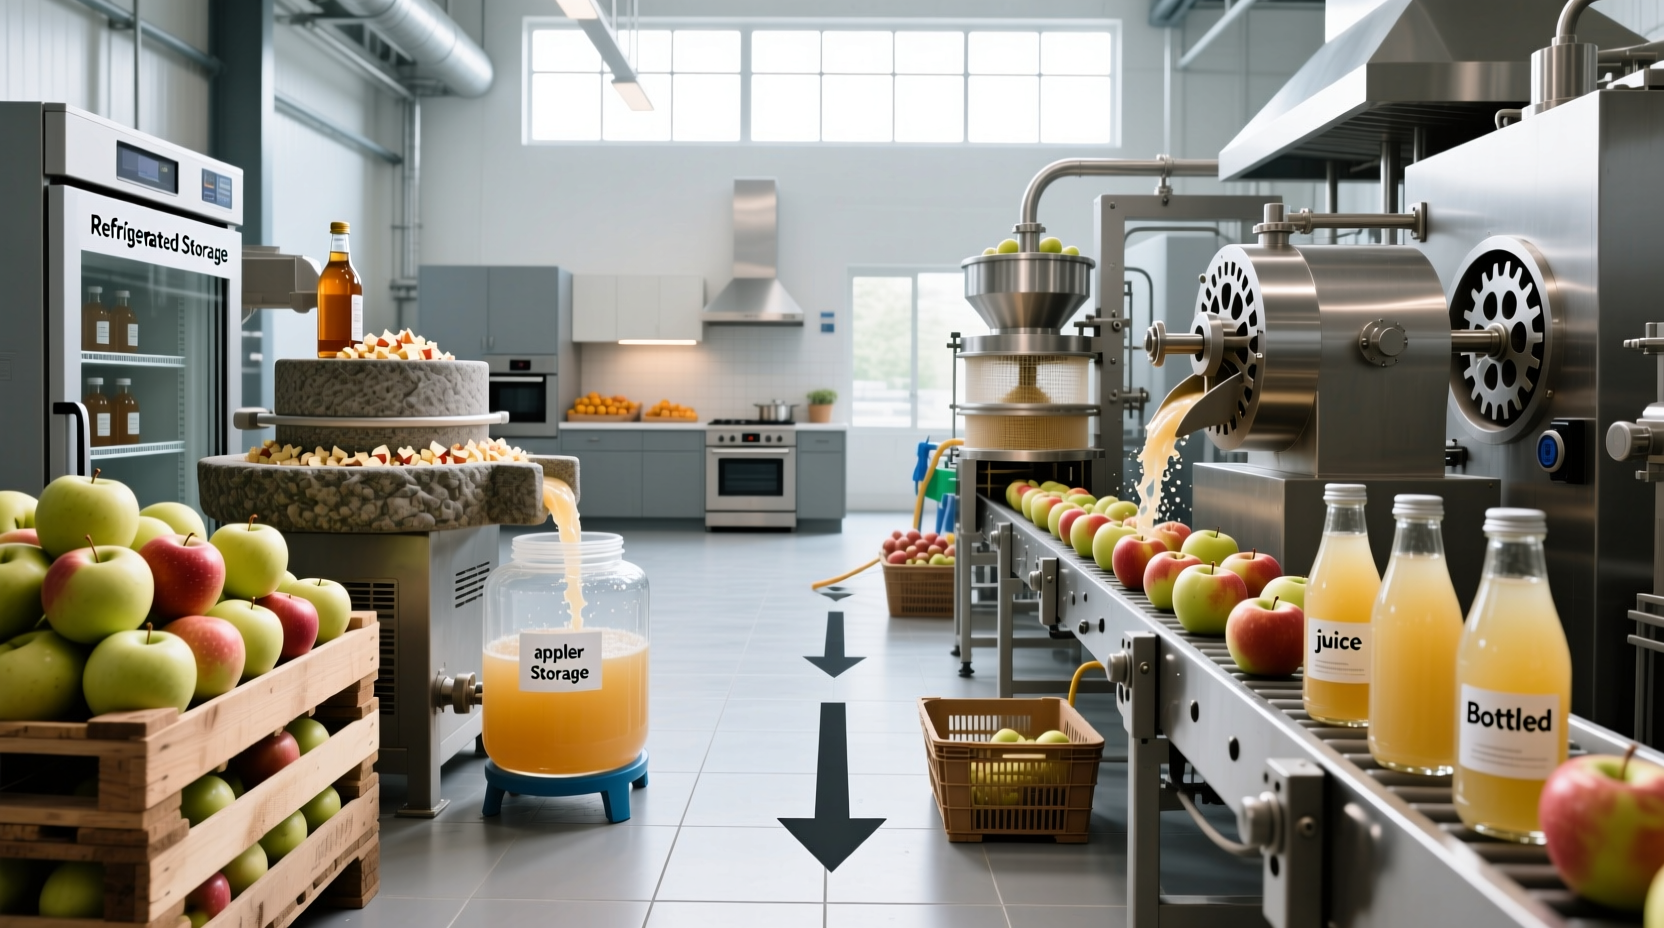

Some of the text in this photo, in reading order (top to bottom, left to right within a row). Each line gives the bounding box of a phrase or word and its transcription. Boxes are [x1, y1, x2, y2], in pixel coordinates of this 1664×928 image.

[91, 214, 228, 265] Refrigerated Storage
[534, 643, 585, 664] appler
[1314, 628, 1363, 654] juice
[530, 665, 590, 684] Storage
[1467, 701, 1552, 732] Bottled
